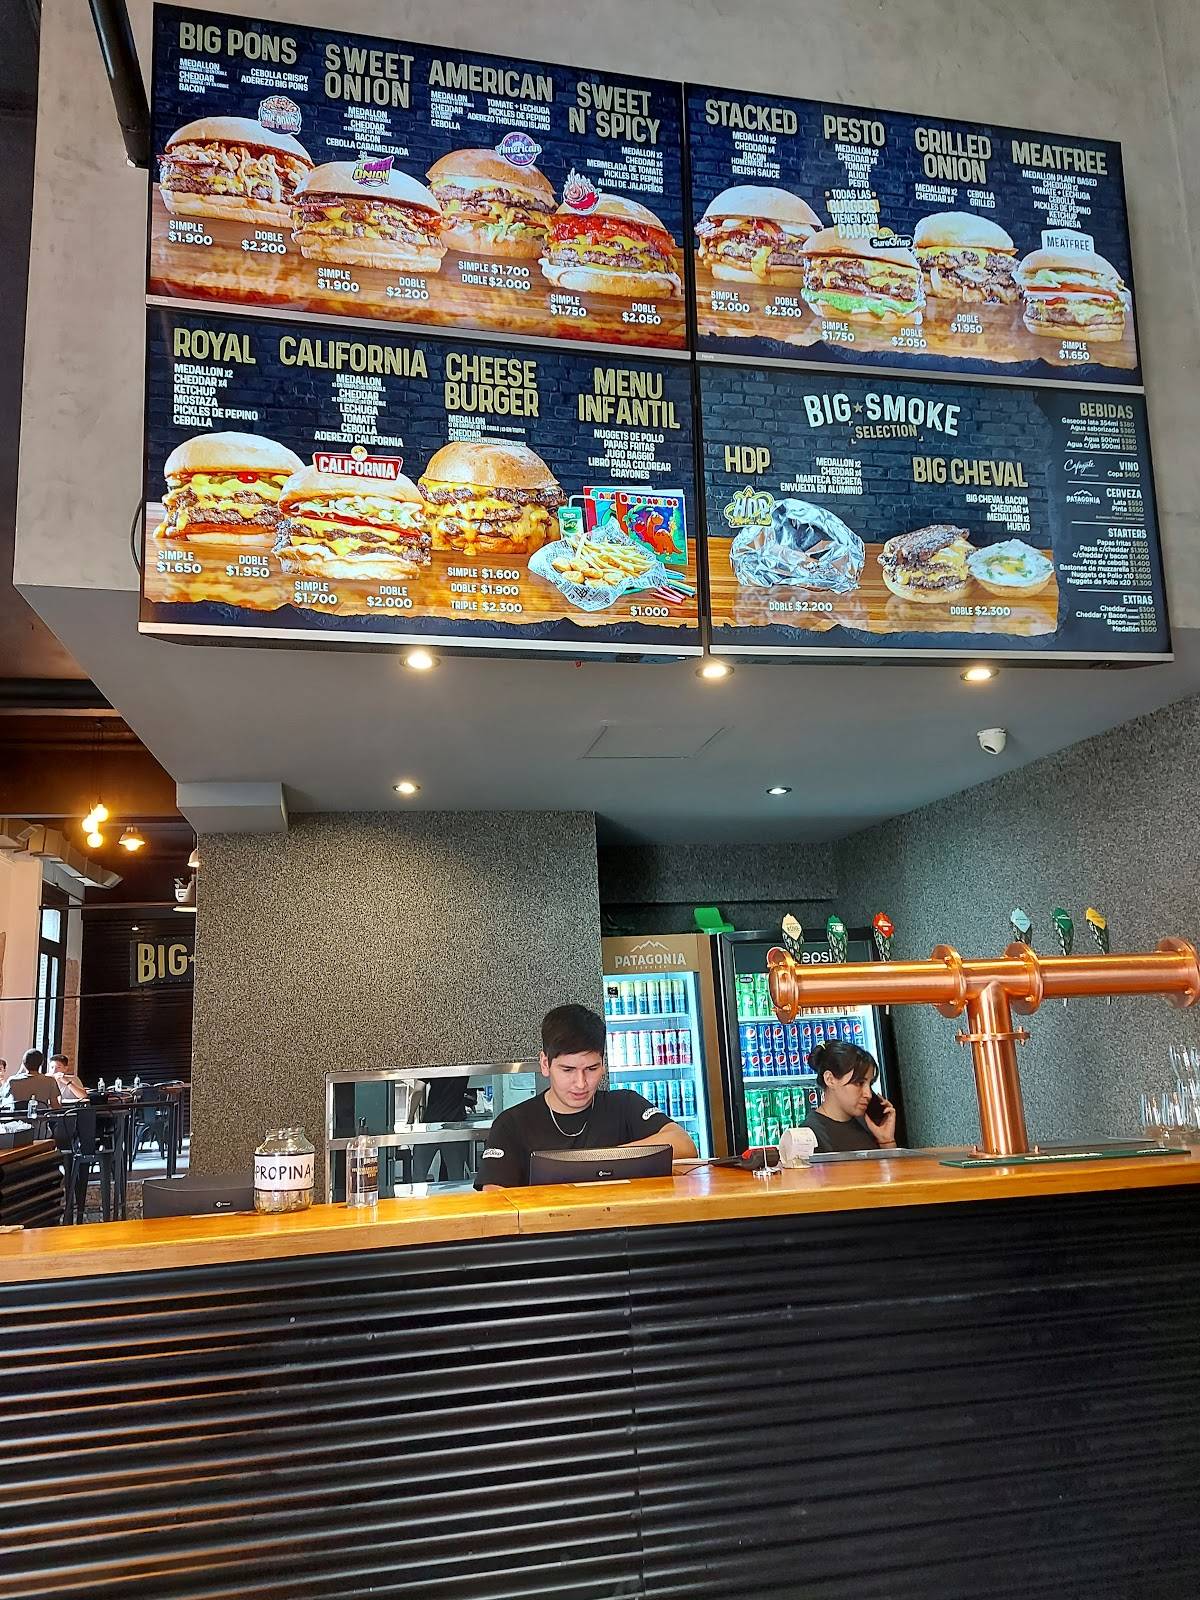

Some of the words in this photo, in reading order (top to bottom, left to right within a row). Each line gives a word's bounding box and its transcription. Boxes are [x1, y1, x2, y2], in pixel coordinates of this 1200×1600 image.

[179, 22, 221, 53] BIG
[227, 29, 297, 64] PONS
[325, 44, 414, 81] SWEET
[428, 59, 553, 102] AMERICAN
[179, 83, 205, 93] BACON
[324, 71, 409, 109] ONION
[577, 81, 651, 116] SWEET
[495, 115, 528, 129] THOUSAND
[704, 99, 798, 135] STACKED
[430, 118, 461, 131] CEBOLLA
[595, 110, 660, 144] SPICY
[823, 114, 886, 147] PESTO
[355, 132, 380, 143] BACON
[732, 131, 769, 143] MEDALLON
[914, 127, 992, 160] GRILLED
[356, 142, 409, 156] CARAMELIZADA
[1011, 140, 1108, 175] MEATFREE
[586, 159, 628, 171] MERMELADA
[923, 153, 987, 184] ONION
[757, 168, 780, 179] SAUCE
[1022, 169, 1056, 181] MEDALLON
[1056, 173, 1076, 184] PLANT
[1077, 177, 1098, 187] BASED
[831, 189, 857, 199] TODAS
[856, 189, 872, 200] LAS
[831, 213, 860, 224] VIENEN
[861, 213, 879, 224] CON
[169, 220, 204, 233] SIMPLE
[168, 230, 213, 246] $1.900
[254, 230, 283, 243] DOBLE
[1046, 235, 1090, 251] MEATFREE
[241, 239, 287, 255] $2.200
[317, 267, 351, 280] SIMPLE
[458, 260, 489, 273] SIMPLE
[490, 264, 530, 278] $1.700
[317, 278, 360, 293] $1.900
[399, 276, 426, 289] DOBLE
[461, 273, 488, 286] DOBLE
[488, 277, 531, 291] $2.000
[386, 285, 429, 300] $2.200
[710, 290, 739, 301] SIMPLE
[550, 294, 580, 306] SIMPLE
[775, 296, 798, 307] DOBLE
[550, 305, 587, 317] $1.750
[632, 302, 656, 314] DOBLE
[711, 301, 750, 313] $2.000
[764, 306, 802, 318] $2.300
[622, 312, 662, 325] $2.050
[956, 314, 979, 324] DOBLE
[821, 321, 849, 331] SIMPLE
[901, 327, 923, 338] DOBLE
[950, 323, 983, 334] $1.950
[821, 331, 855, 342] $1.750
[890, 337, 927, 348] $2.050
[173, 327, 257, 364] ROYAL
[1062, 340, 1087, 351] SIMPLE
[279, 335, 428, 378] CALIFORNIA
[1059, 350, 1090, 361] $1.650
[174, 363, 223, 377] MEDALLON
[224, 369, 234, 378] x2
[445, 352, 537, 388] CHEESE
[174, 373, 217, 387] CHEDDAR
[218, 379, 228, 388] x4
[593, 367, 663, 400] MENU
[174, 383, 216, 396] KETCHUP
[174, 394, 218, 407] MOSTAZA
[445, 381, 539, 417] BURGER
[174, 404, 210, 417] PICKLES
[211, 408, 224, 418] DE
[225, 408, 258, 421] PEPINO
[339, 403, 379, 416] LECHUGA
[578, 393, 681, 429] INFANTIL
[803, 393, 851, 428] BIG
[865, 392, 961, 436] SMOKE
[1079, 402, 1134, 419] BEBIDAS
[173, 414, 213, 427] CEBOLLA
[342, 413, 377, 426] TOMATE
[340, 423, 378, 435] CEBOLLA
[593, 428, 629, 441] NUGGETS
[629, 431, 641, 441] DE
[641, 432, 664, 443] POLLO
[855, 424, 917, 439] SELECTION
[314, 431, 353, 443] ADEREZO
[354, 435, 404, 447] CALIFORNIA
[603, 439, 629, 450] PAPAS
[629, 441, 655, 452] FRITAS
[605, 449, 626, 459] JUGO
[626, 450, 655, 462] BAGGIO
[724, 445, 771, 474] HDP
[319, 456, 396, 479] CALIFORNIA
[610, 459, 632, 469] PARA
[1119, 461, 1139, 471] VINO
[610, 468, 650, 480] CRAYONES
[912, 456, 947, 484] BIG
[950, 458, 1029, 488] CHEVAL
[831, 476, 863, 486] SECRETA
[1066, 495, 1100, 504] PATAGONIA
[1106, 488, 1142, 499] CERVEZA
[733, 497, 770, 520] HDP
[1007, 522, 1031, 532] HUEVO
[1107, 528, 1147, 538] STARTERS
[1079, 545, 1098, 553] Papas
[1096, 539, 1115, 547] Papas
[158, 550, 194, 561] SIMPLE
[238, 554, 268, 566] DOBLE
[156, 562, 202, 574] $1.650
[225, 565, 270, 578] $1.950
[447, 567, 478, 578] SIMPLE
[481, 569, 520, 580] $1.600
[294, 581, 329, 592] SIMPLE
[379, 585, 408, 596] DOBLE
[450, 583, 477, 593] DOBLE
[480, 585, 519, 596] $1.900
[293, 592, 338, 605] $1.700
[367, 596, 413, 609] $2.000
[1123, 595, 1153, 605] EXTRAS
[450, 600, 478, 611] TRIPLE
[481, 602, 522, 613] $2.300
[630, 606, 669, 617] $1.000
[769, 601, 793, 612] DOBLE
[795, 601, 833, 612] $2.200
[950, 606, 973, 616] DOBLE
[974, 606, 1011, 617] $2.300
[137, 943, 188, 983] BIG
[614, 952, 687, 968] PATAGONIA
[802, 949, 832, 964] epsi
[255, 1163, 311, 1181] PROPINA
